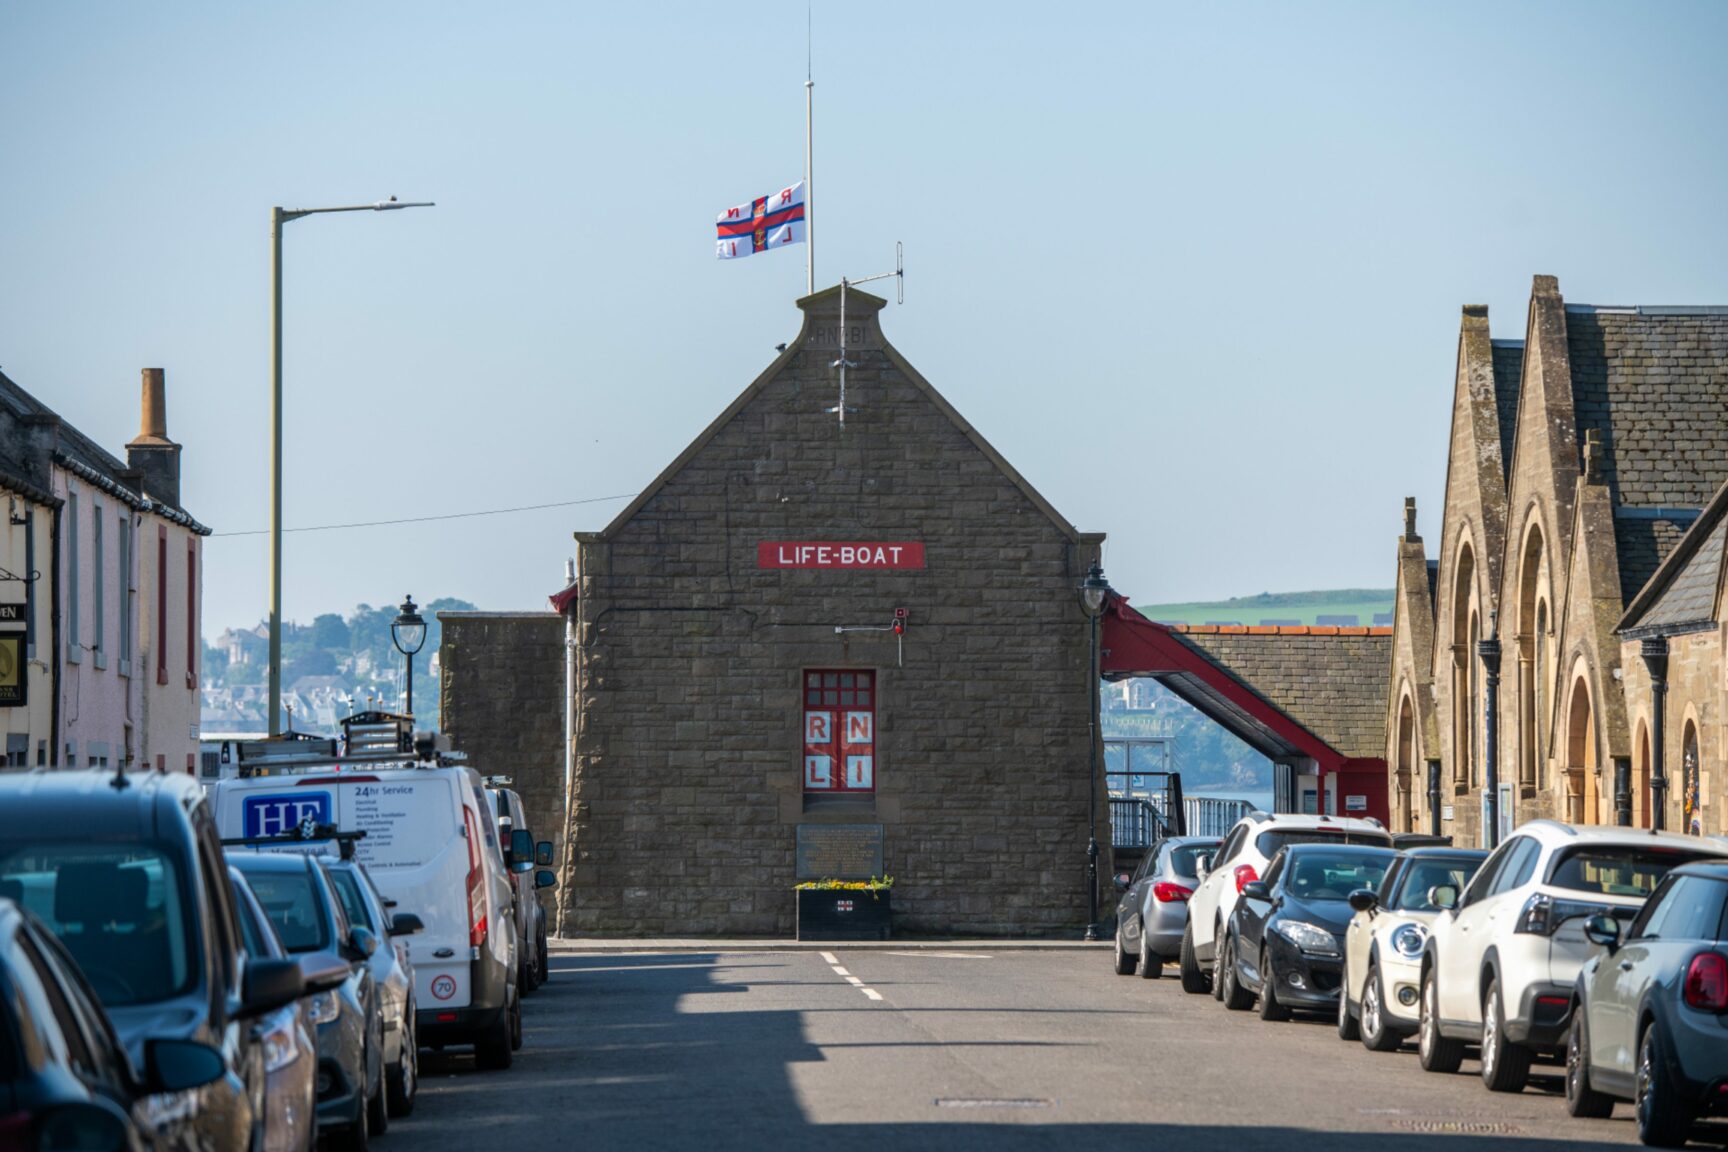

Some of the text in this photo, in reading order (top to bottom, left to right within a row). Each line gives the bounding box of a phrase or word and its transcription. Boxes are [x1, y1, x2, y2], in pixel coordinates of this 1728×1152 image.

[778, 546, 903, 564] LIFE-BOAT
[809, 715, 869, 738] R N
[810, 760, 825, 783] L
[355, 785, 414, 797] 24hr Service
